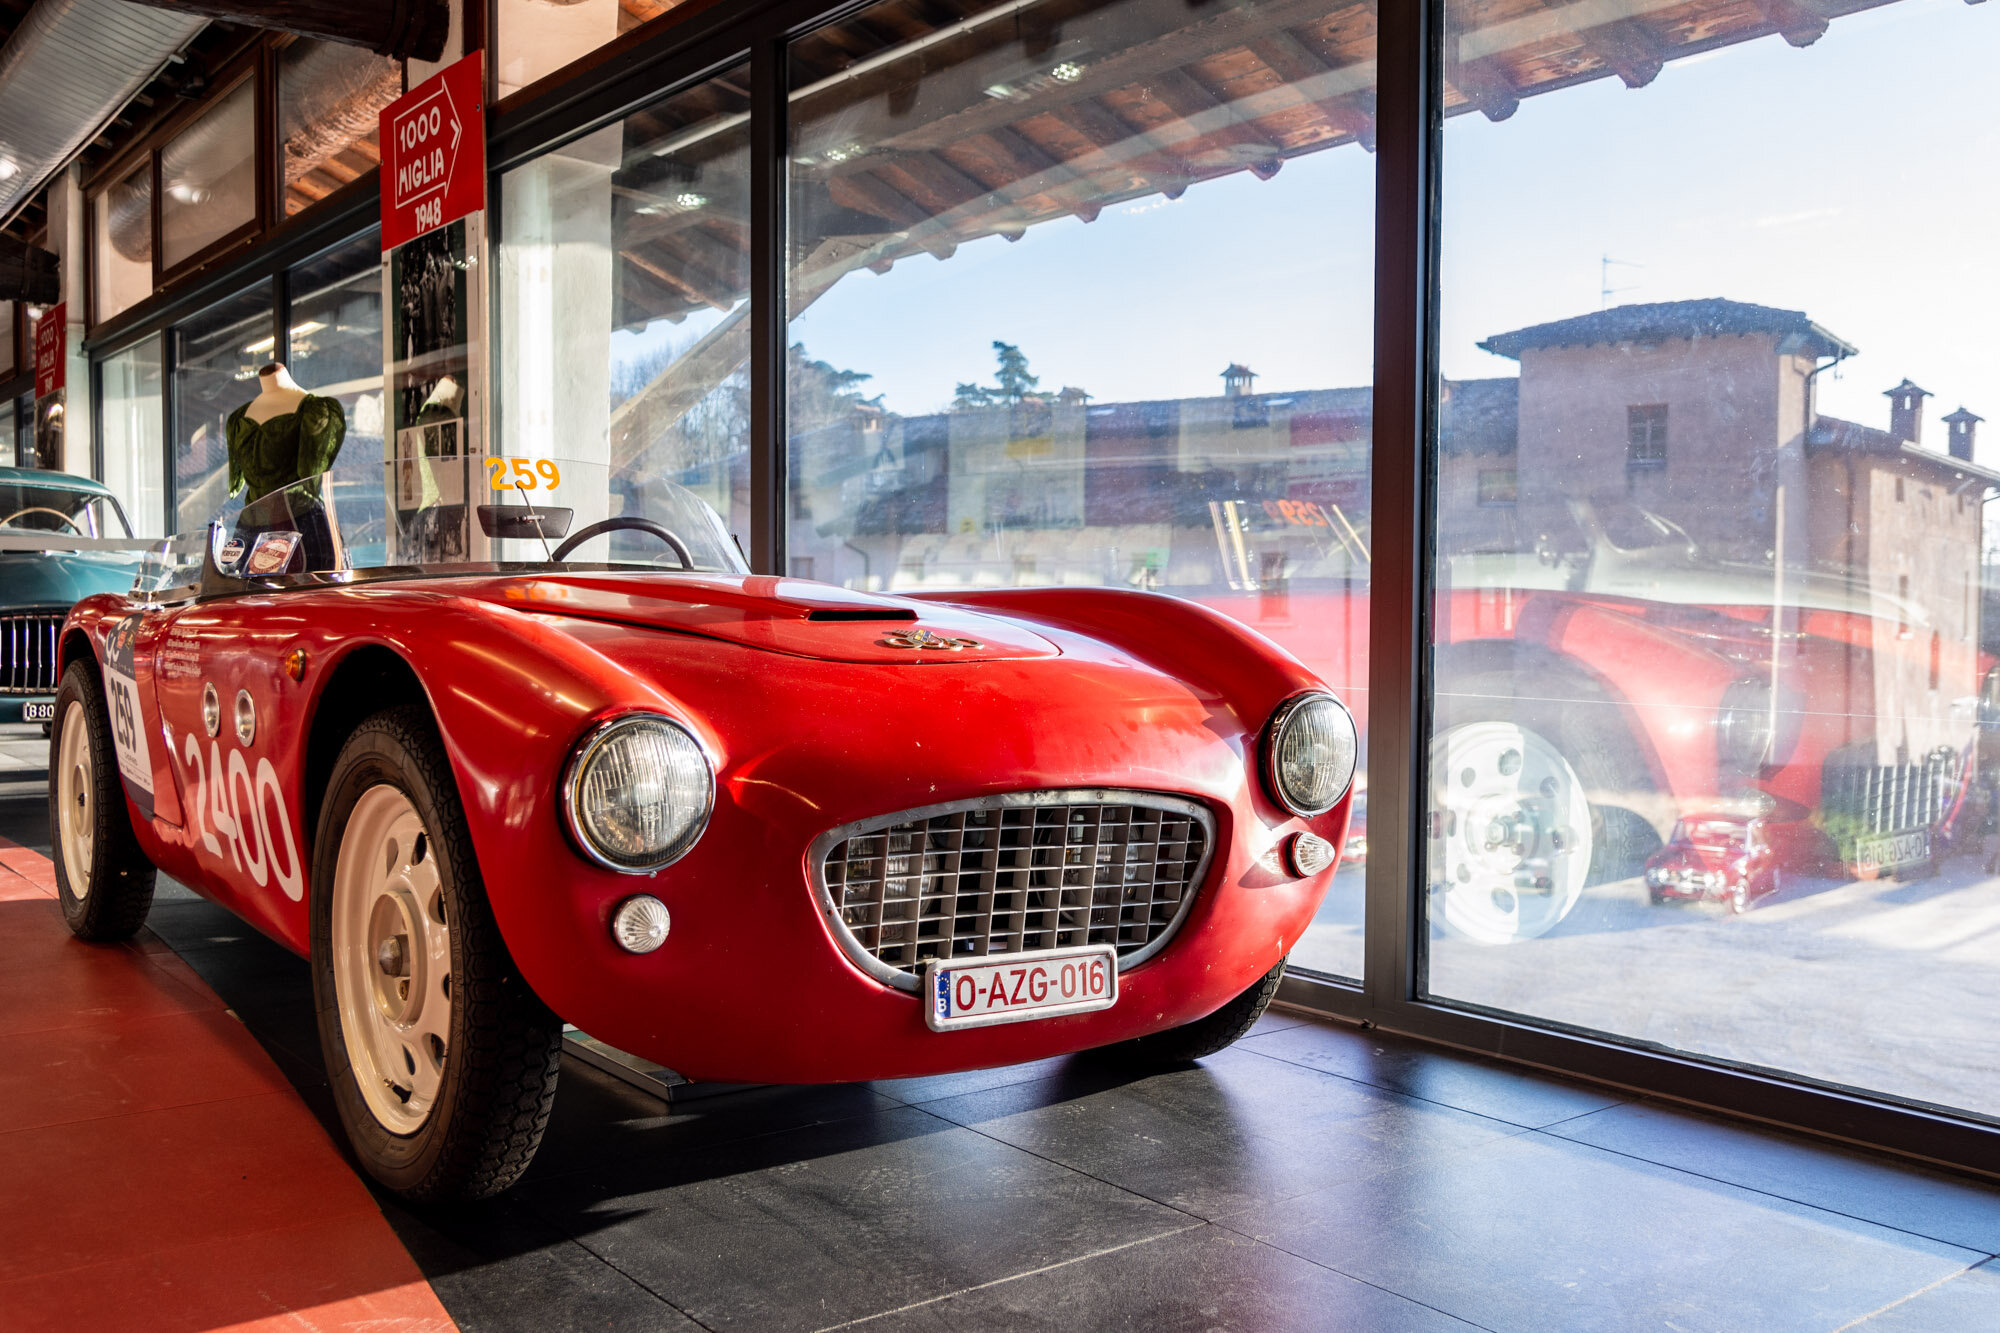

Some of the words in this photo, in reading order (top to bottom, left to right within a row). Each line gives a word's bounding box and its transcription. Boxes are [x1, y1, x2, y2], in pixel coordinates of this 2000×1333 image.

[400, 106, 441, 152] 1000
[398, 147, 445, 197] MIGLIA
[415, 197, 442, 234] 1948
[484, 457, 561, 490] 259
[110, 677, 137, 754] 259
[185, 733, 304, 902] 2400
[937, 997, 947, 1013] B
